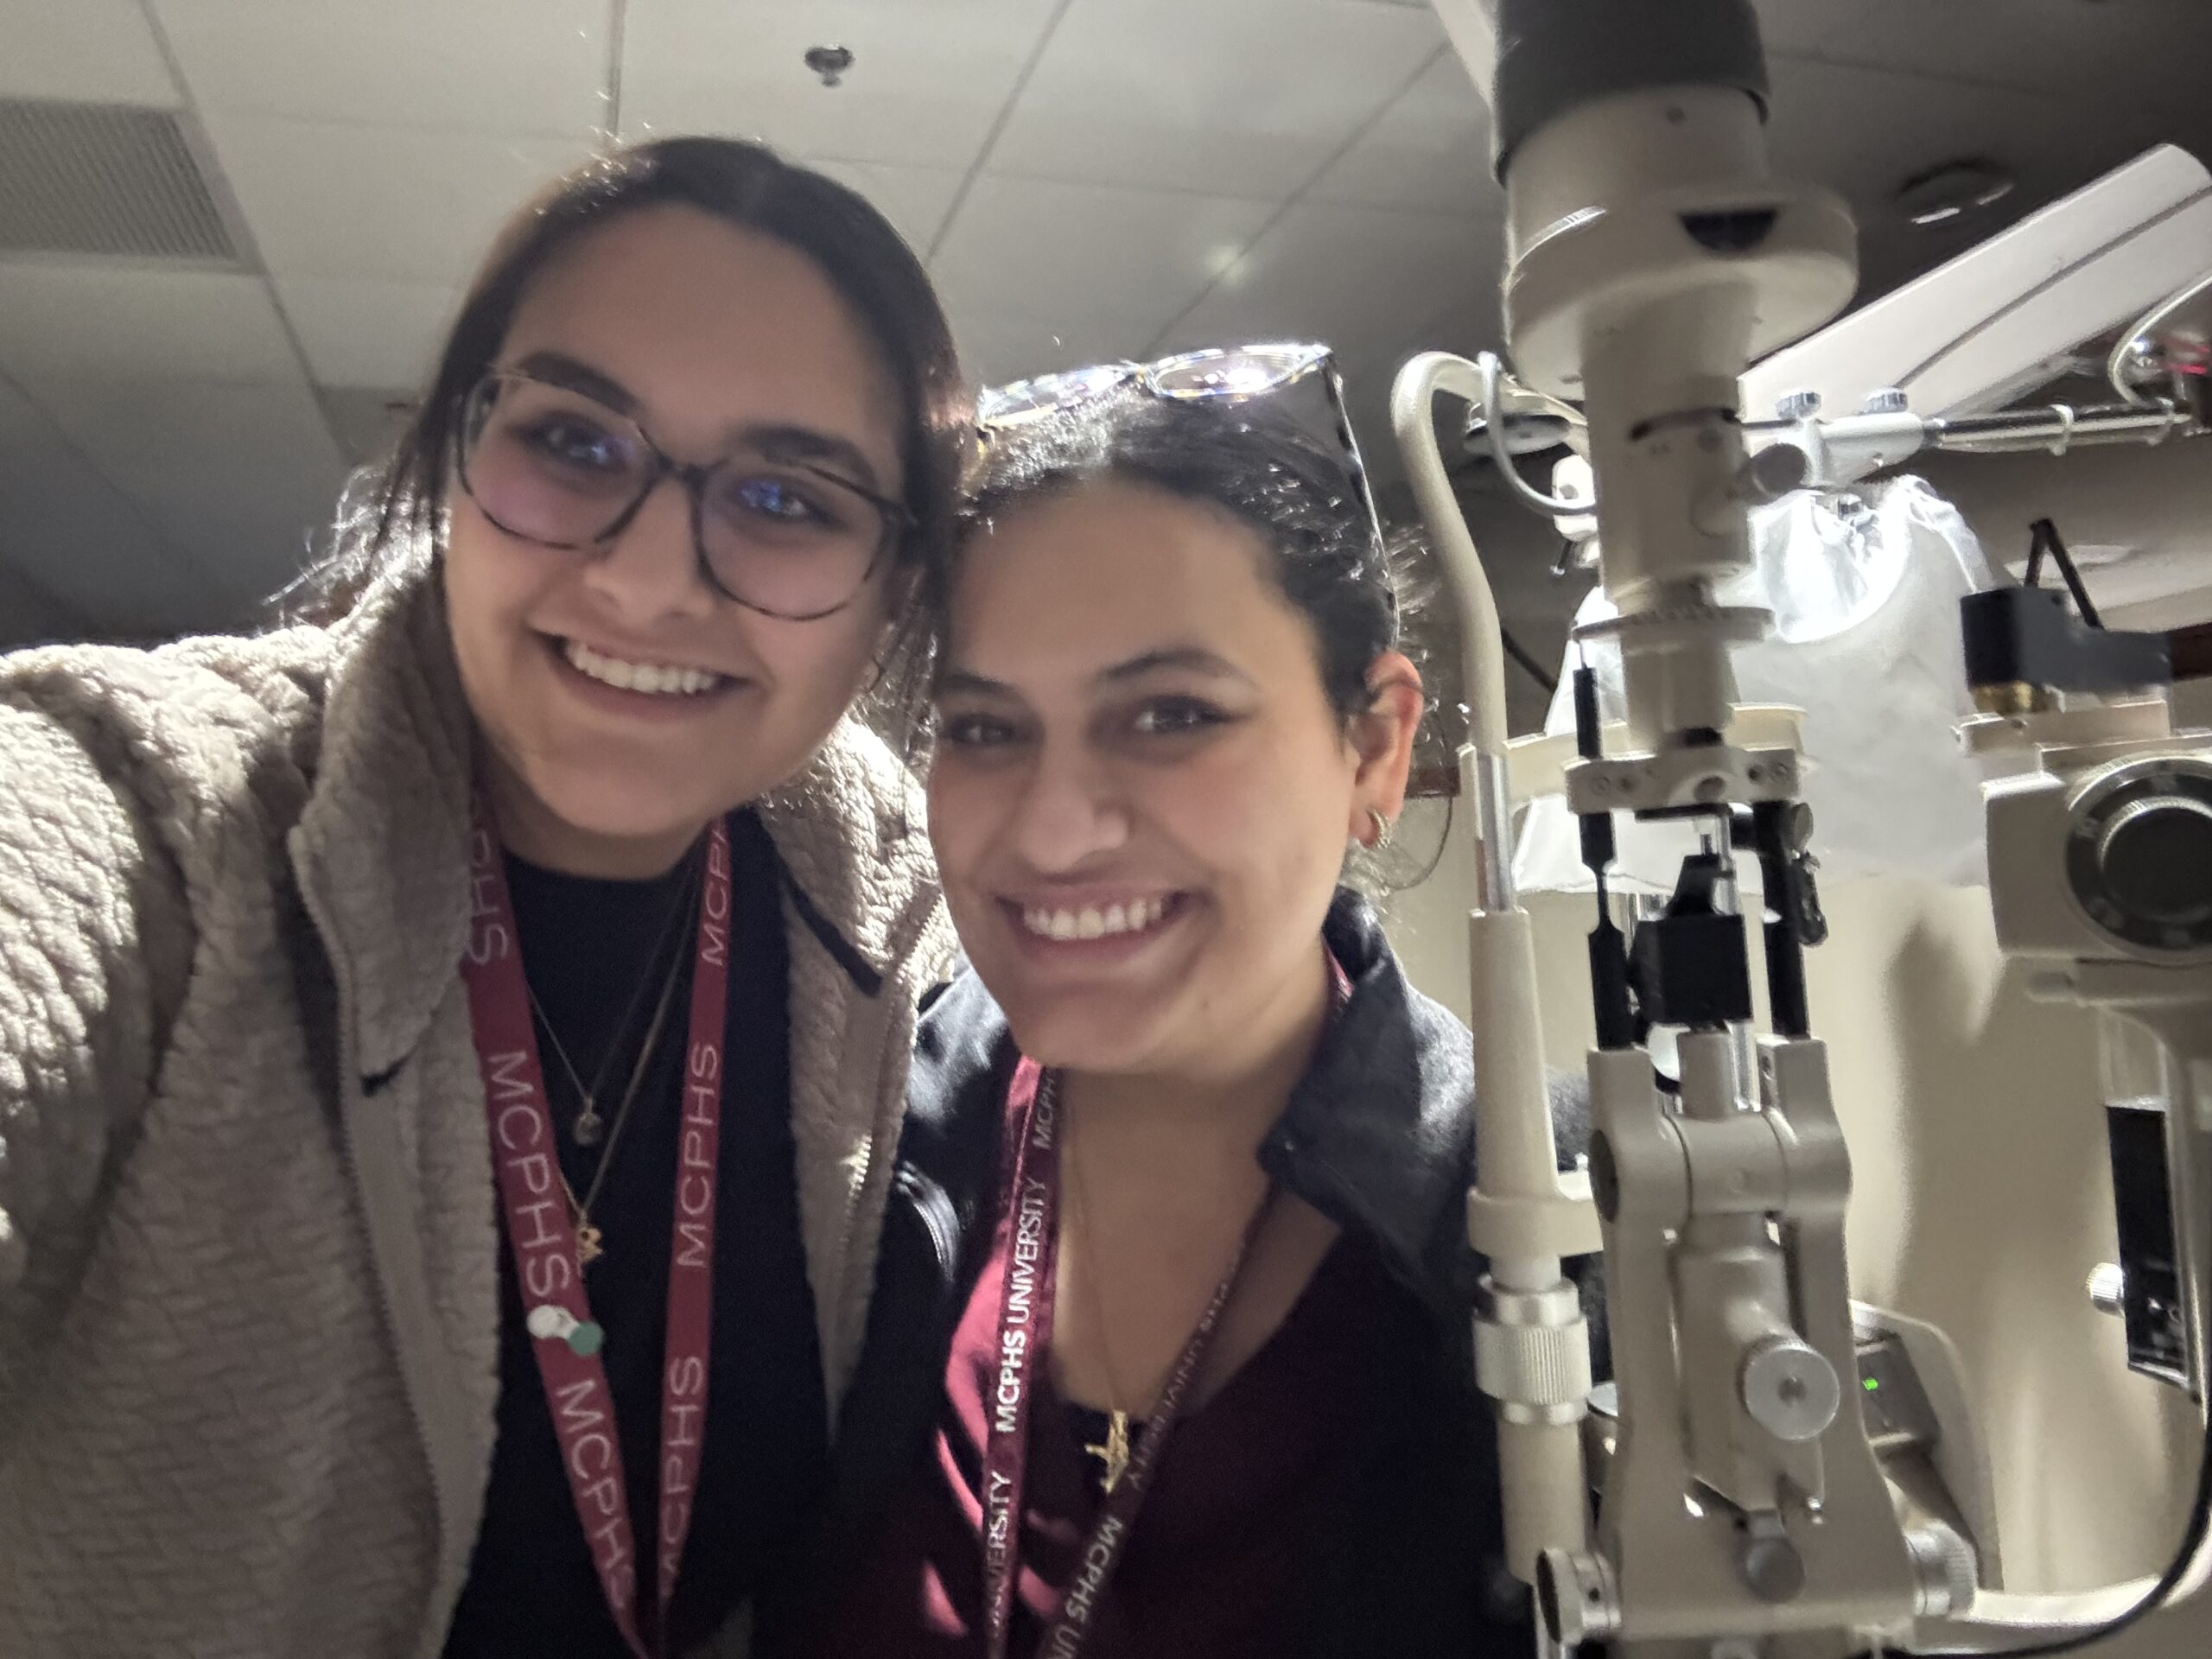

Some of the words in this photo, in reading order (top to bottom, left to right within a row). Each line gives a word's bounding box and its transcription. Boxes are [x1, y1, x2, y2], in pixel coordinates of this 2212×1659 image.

[467, 829, 508, 965] PHS
[702, 830, 729, 966] MCP
[487, 1050, 570, 1297] MCPHS
[677, 1042, 720, 1268] MCPHS
[1032, 1077, 1056, 1150] MCPH
[1007, 1176, 1046, 1324] UNIVERSITY
[995, 1330, 1027, 1433] MCPHS
[557, 1379, 634, 1609] MCPHS
[1065, 1516, 1123, 1624] MCPHS
